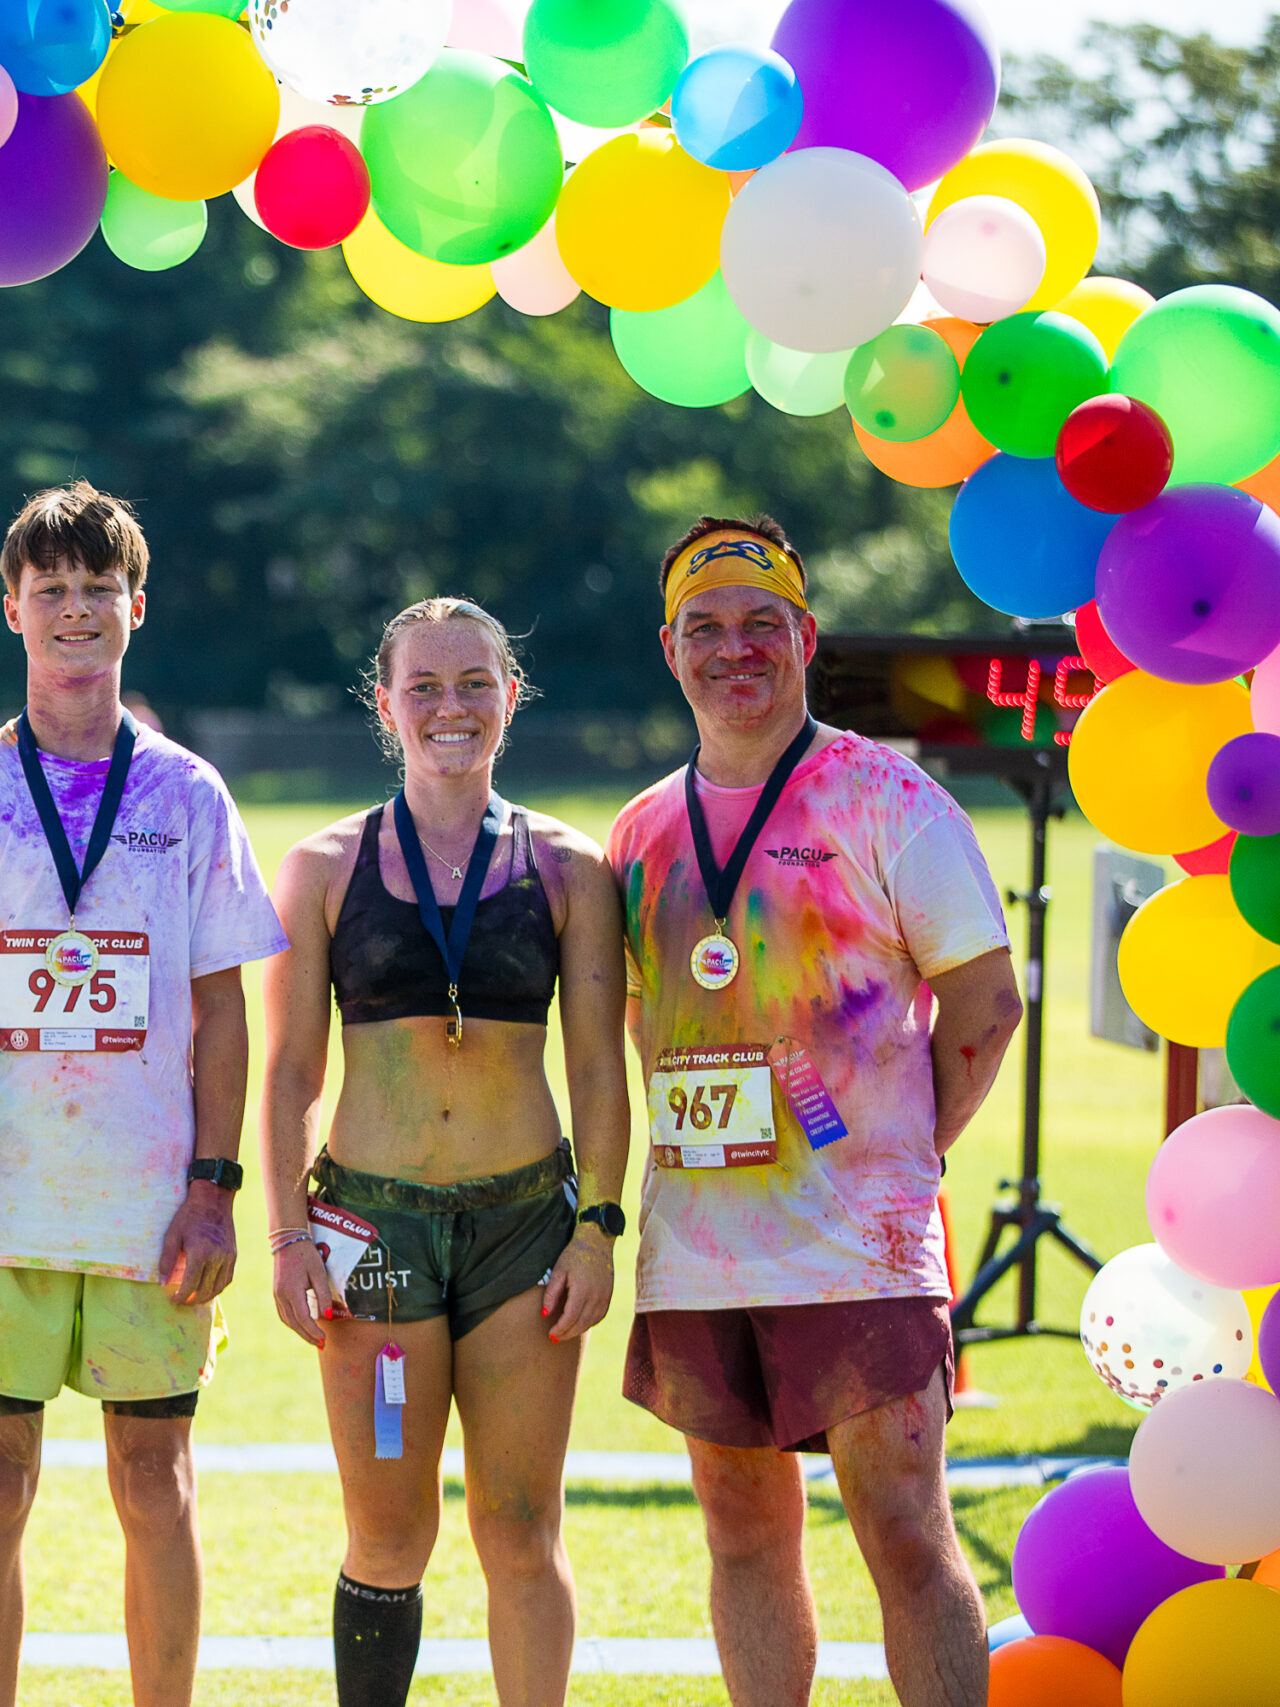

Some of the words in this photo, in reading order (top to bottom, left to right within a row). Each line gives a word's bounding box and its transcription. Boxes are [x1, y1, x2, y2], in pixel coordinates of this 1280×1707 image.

[129, 832, 167, 847] PACU
[780, 847, 822, 861] PACU
[6, 938, 35, 948] TWIN
[111, 938, 143, 949] CLUB
[692, 1053, 730, 1065] TRACK
[732, 1051, 765, 1062] CLUB
[668, 1084, 738, 1131] 967
[730, 1149, 770, 1160] @twincitytc
[311, 1206, 343, 1225] TRACK
[342, 1220, 372, 1237] CLUB
